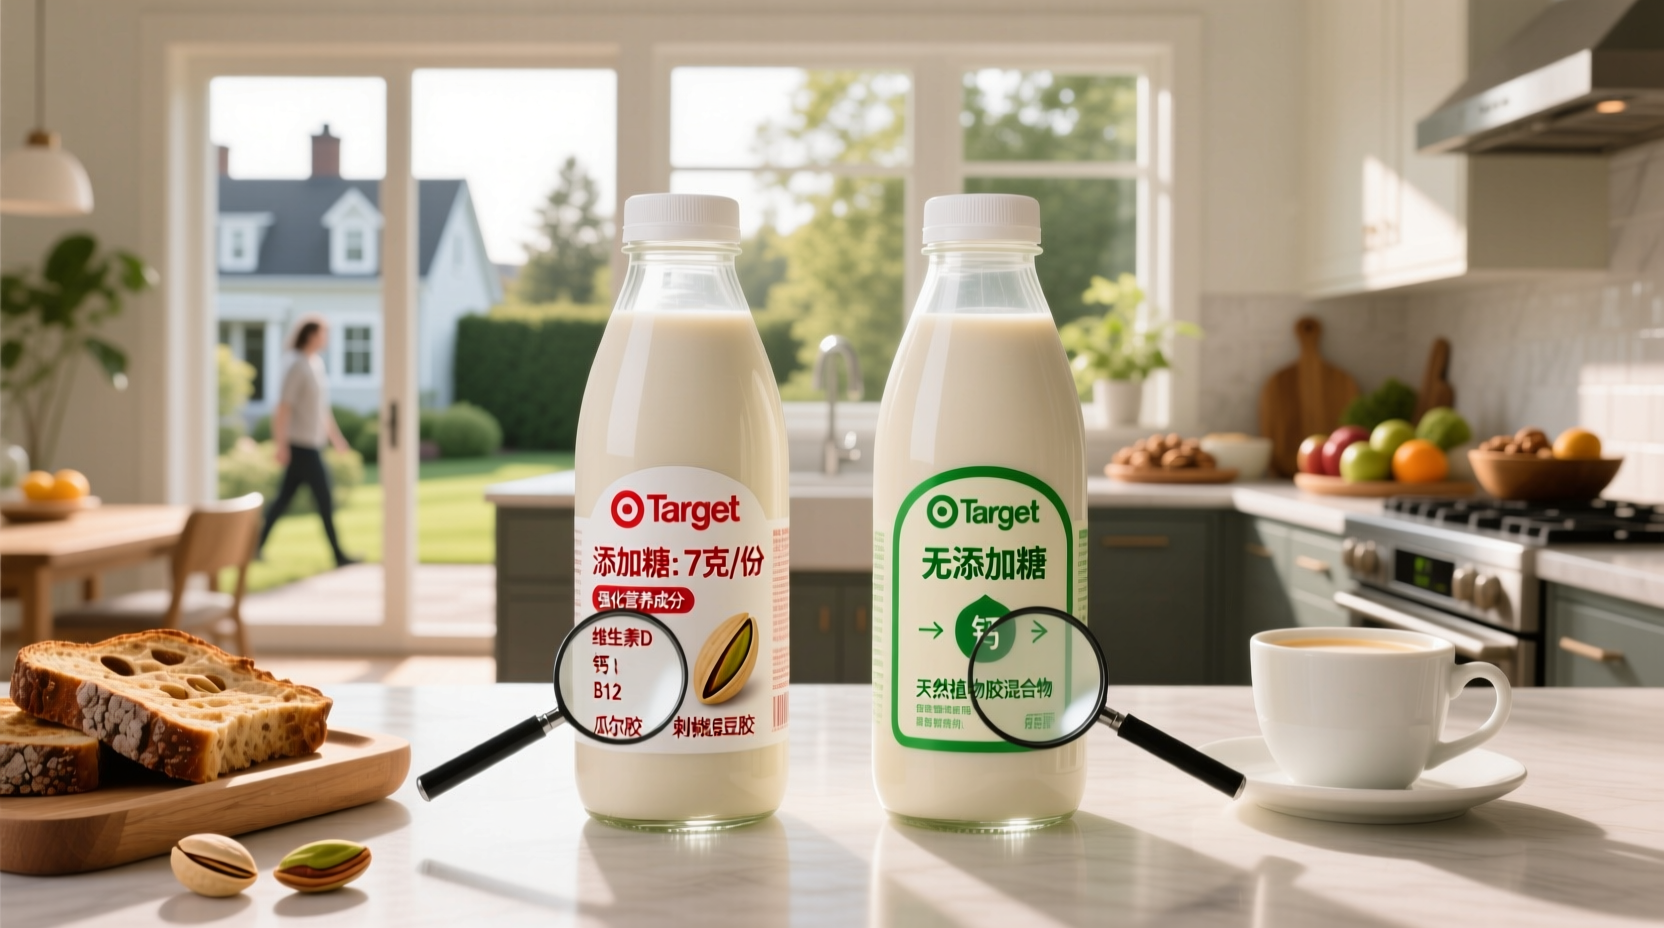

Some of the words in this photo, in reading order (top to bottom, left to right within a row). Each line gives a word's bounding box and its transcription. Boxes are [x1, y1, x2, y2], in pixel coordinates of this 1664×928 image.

[647, 494, 741, 531] Target
[960, 498, 1040, 531] Target
[921, 545, 1047, 581] 无添加糖
[971, 614, 1001, 651] 钙
[594, 681, 622, 701] B12
